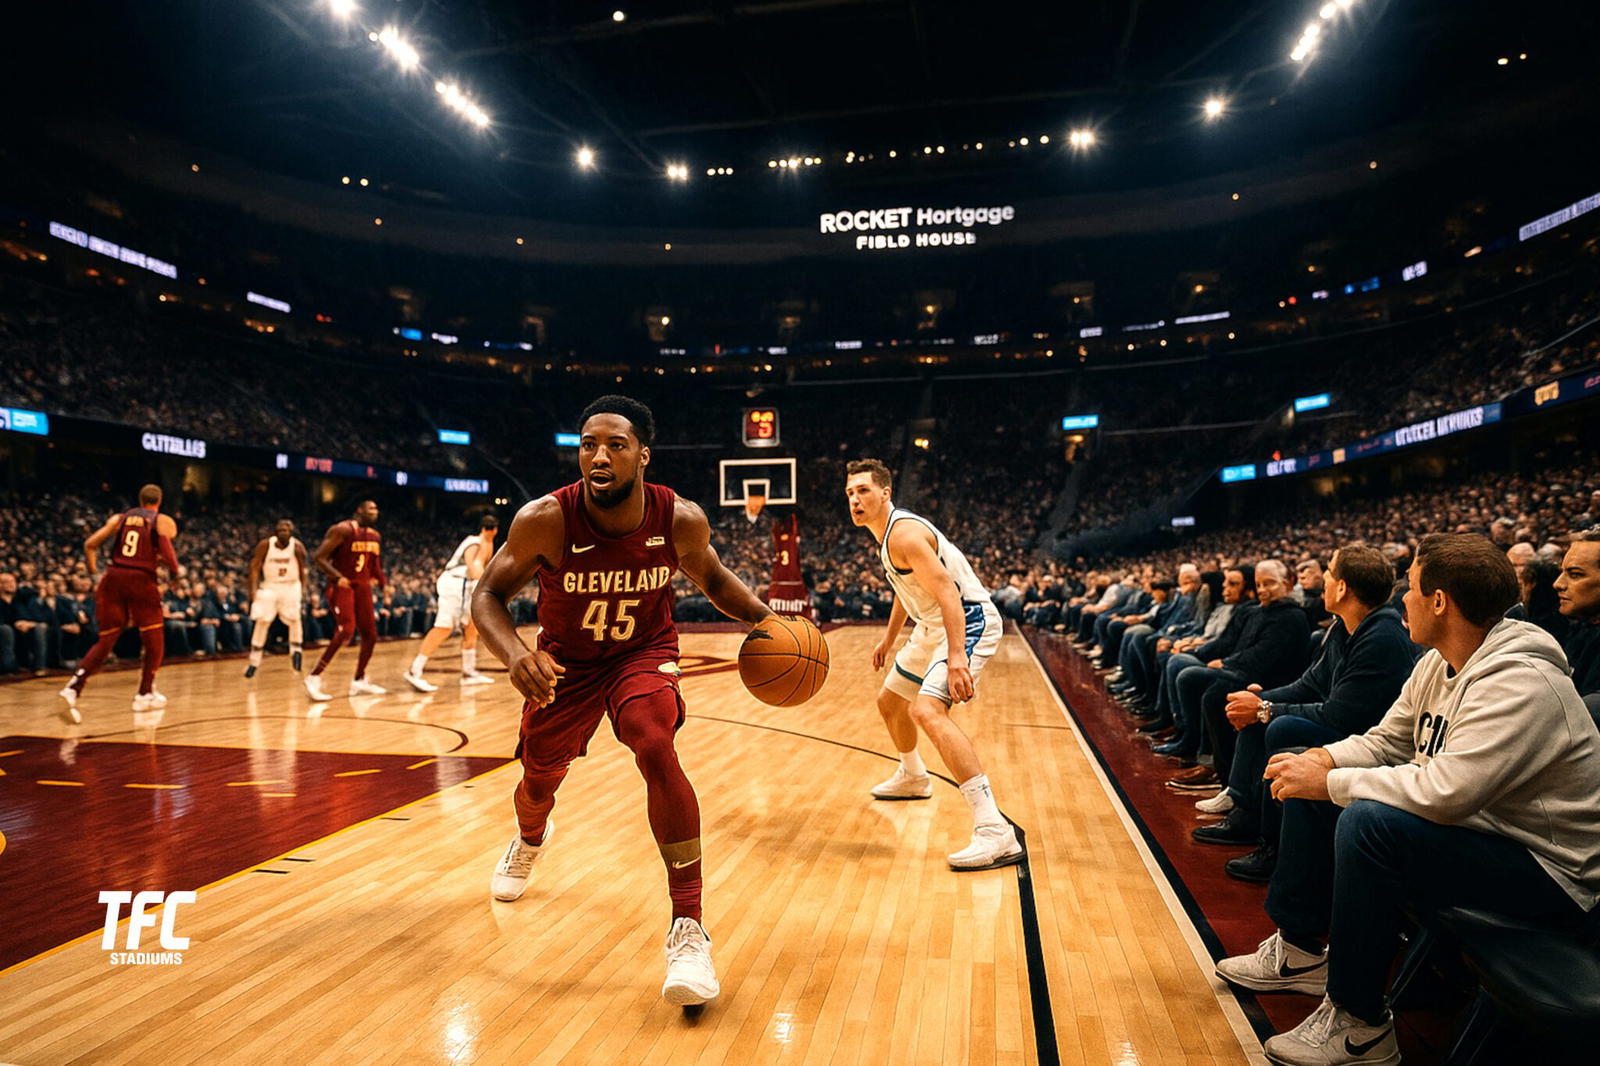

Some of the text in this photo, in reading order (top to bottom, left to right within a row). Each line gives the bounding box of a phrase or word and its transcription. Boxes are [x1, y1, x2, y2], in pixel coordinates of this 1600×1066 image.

[820, 207, 913, 233] ROCKET
[122, 530, 140, 557] 9
[582, 599, 640, 641] 45
